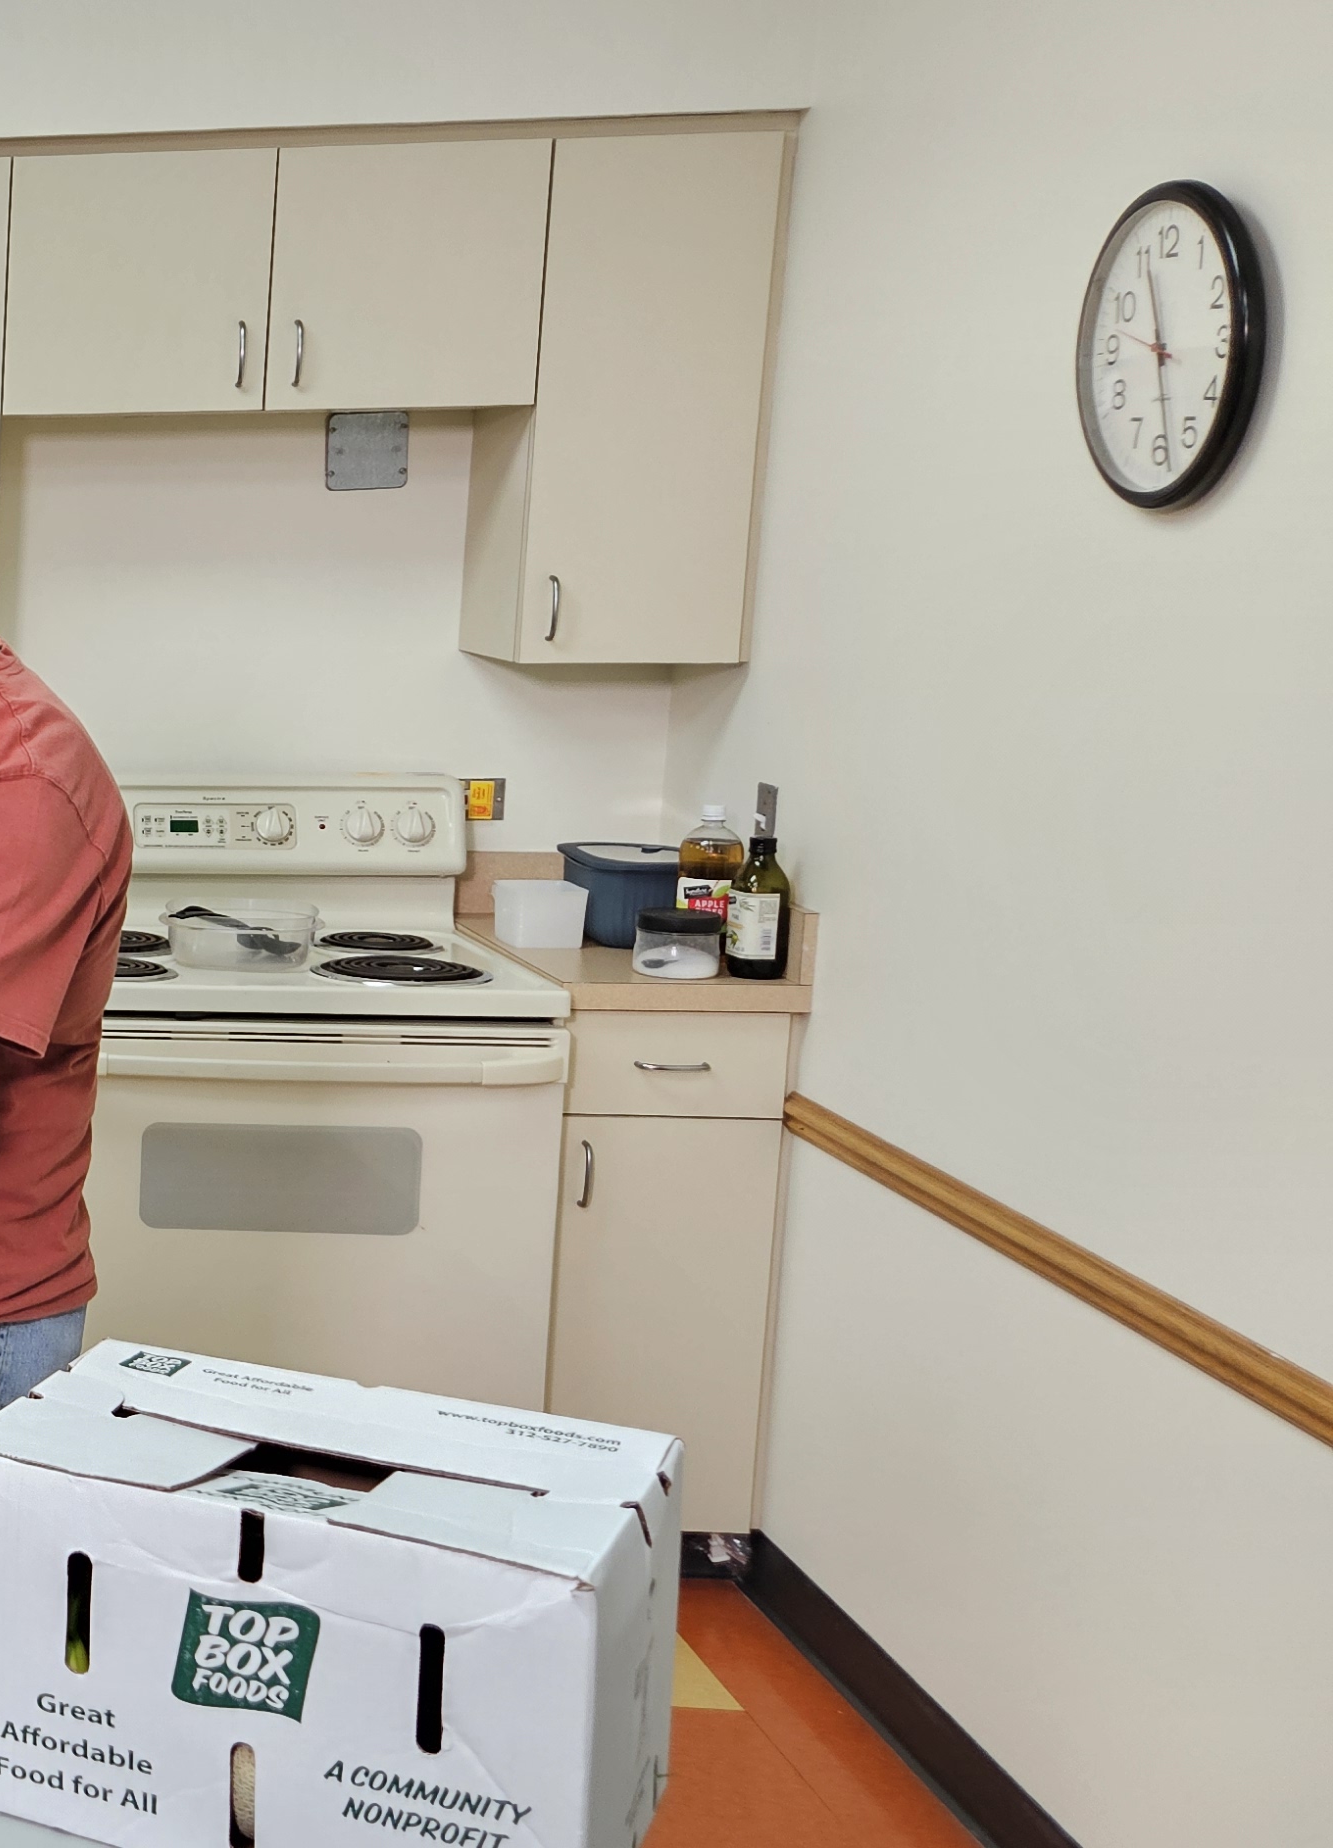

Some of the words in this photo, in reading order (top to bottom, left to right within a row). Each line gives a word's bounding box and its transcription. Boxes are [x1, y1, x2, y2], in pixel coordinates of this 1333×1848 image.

[1158, 225, 1179, 258] 12
[1196, 235, 1204, 270] 1
[1136, 245, 1152, 278] 11
[1114, 291, 1137, 324] 10
[1210, 274, 1225, 310] 2
[1106, 334, 1120, 365] 9
[1215, 325, 1229, 359] 3
[1112, 379, 1127, 410] 8
[1203, 375, 1218, 407] 4
[1129, 417, 1144, 449] 7
[1181, 416, 1198, 449] 5
[1152, 434, 1169, 466] 6
[694, 899, 725, 908] APPLE
[202, 1367, 239, 1380] Great
[242, 1374, 314, 1393] Affordable
[213, 1376, 248, 1389] Food
[250, 1383, 268, 1391] for
[271, 1386, 292, 1396] All
[437, 1409, 622, 1446] www.topboxfoods.com
[505, 1428, 620, 1453] 312-527-7890
[200, 1603, 300, 1648] TOP
[193, 1633, 294, 1685] BOX
[191, 1667, 290, 1709] FOODS
[36, 1692, 116, 1729] Great
[0, 1720, 153, 1775] Affordable
[71, 1774, 114, 1803] for
[120, 1788, 158, 1816] All
[323, 1759, 344, 1783] A
[350, 1765, 533, 1825] COMMUNITY
[341, 1796, 511, 1848] NONPROFIT
